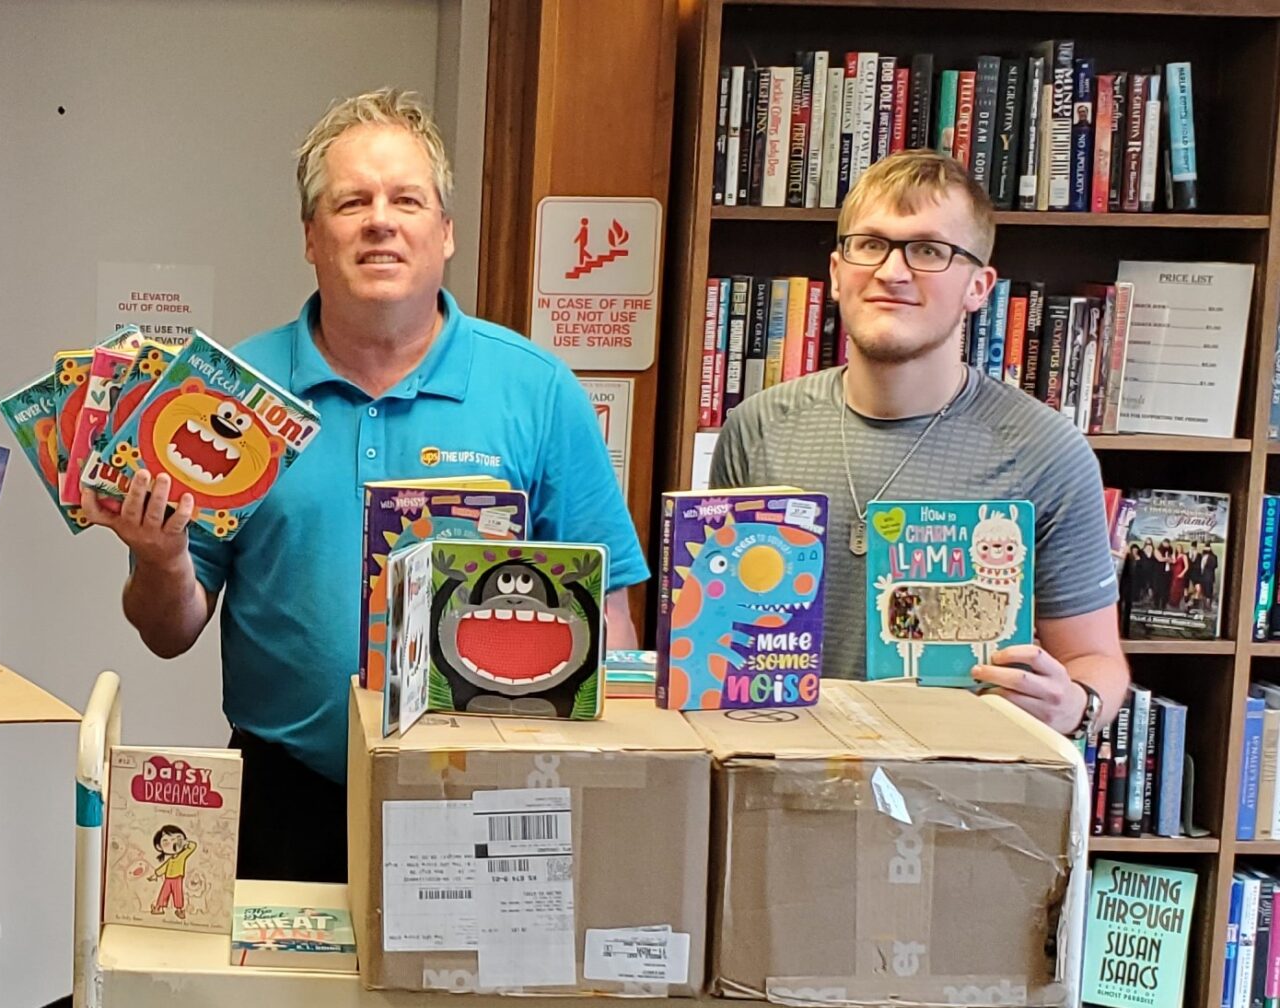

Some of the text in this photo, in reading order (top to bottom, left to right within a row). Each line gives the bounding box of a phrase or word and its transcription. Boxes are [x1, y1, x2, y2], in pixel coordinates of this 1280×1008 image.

[758, 72, 770, 103] HIGH
[864, 60, 875, 112] COLIN
[882, 62, 893, 82] BOB
[844, 81, 854, 129] AMERICAN
[880, 84, 891, 111] DOLE
[1003, 66, 1017, 131] SUE GRAFTON
[1053, 68, 1064, 116] BODY
[1064, 68, 1073, 116] MIND
[756, 106, 767, 135] JINX
[895, 107, 903, 140] CHILD
[1129, 96, 1141, 138] GRAFTON
[789, 123, 805, 192] PERFECT JUSTICE
[841, 139, 850, 181] JOURNEY
[975, 112, 989, 185] DEAN KOON
[1127, 141, 1142, 152] R
[1076, 134, 1085, 194] NO APOLOGY
[1159, 273, 1214, 283] PRICE LIST
[118, 302, 138, 311] OUT
[156, 304, 192, 313] ORDER.
[131, 292, 180, 301] ELEVATOR
[538, 298, 652, 310] IN CASE OF FIRE
[1028, 290, 1038, 332] BERNHARDT
[116, 324, 193, 334] PLSE USE THE
[551, 311, 637, 322] DO NOT USE
[556, 324, 630, 334] ELEVATORS
[753, 284, 765, 353] DAYS OF GRACE
[995, 319, 1003, 337] WAY
[553, 336, 632, 347] USE STAIRS
[1050, 319, 1064, 368] OLYMPUS
[188, 354, 215, 379] NEVER
[1026, 339, 1039, 380] EXTREME
[700, 385, 712, 408] BAKER
[14, 405, 41, 425] NEVER
[441, 452, 457, 462] THE
[459, 452, 474, 463] UPS
[475, 453, 501, 467] STORE
[1265, 498, 1276, 533] GONE
[906, 524, 956, 543] CHARM
[959, 527, 967, 541] A
[889, 543, 965, 578] LLAMA
[1262, 535, 1273, 569] WILD
[756, 654, 811, 671] some
[728, 673, 819, 704] noise
[1145, 773, 1153, 797] BLACK
[1109, 866, 1182, 904] SHINING
[242, 916, 333, 929] GREAT
[1096, 891, 1184, 934] THROUGH
[1105, 932, 1162, 963] SUSAN
[1100, 958, 1159, 990] ISAACS
